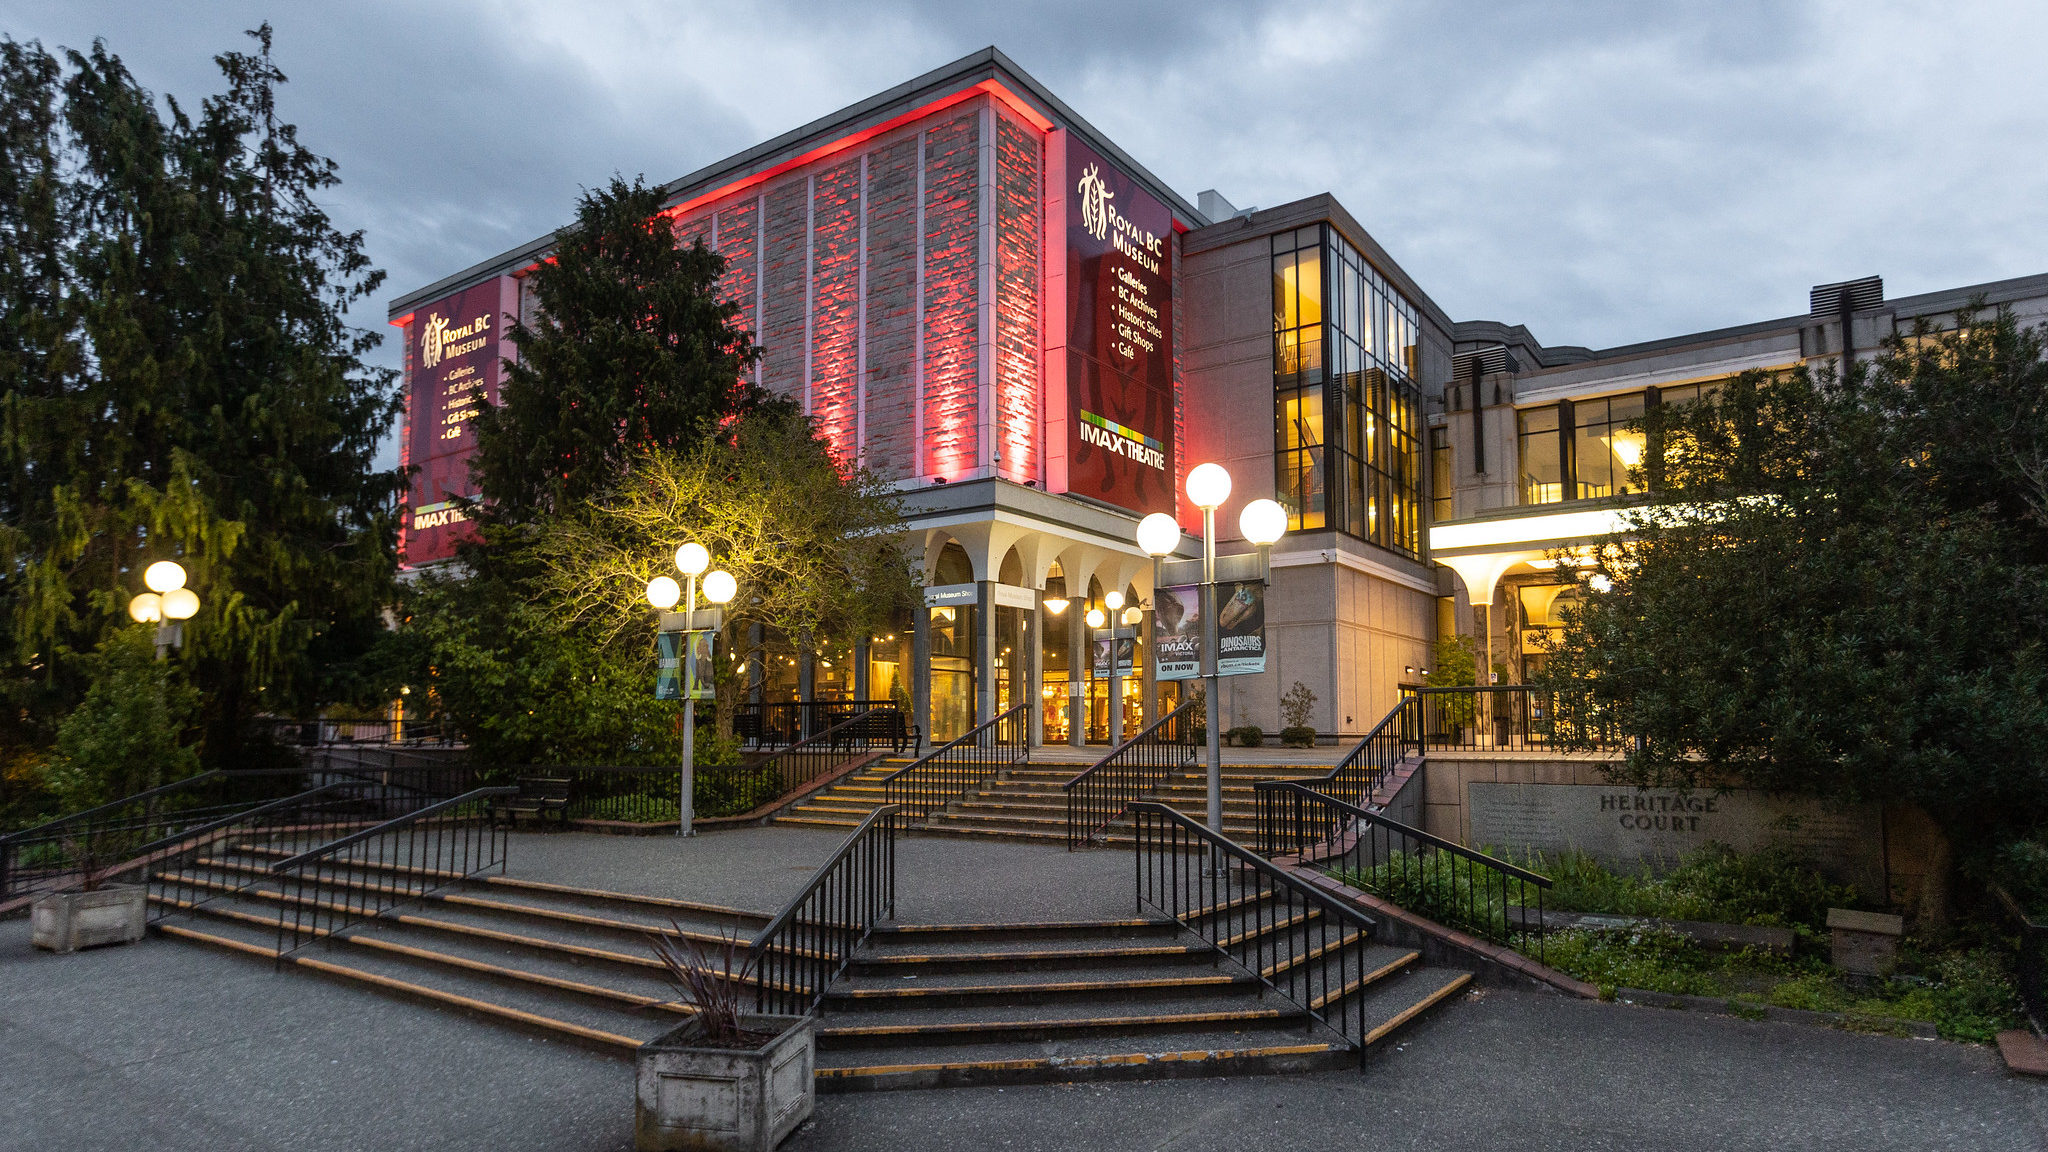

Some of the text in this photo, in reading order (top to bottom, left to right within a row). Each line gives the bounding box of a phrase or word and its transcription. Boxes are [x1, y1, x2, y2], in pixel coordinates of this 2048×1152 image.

[1108, 203, 1163, 258] ROYAL BC
[1113, 229, 1159, 275] MUSEUM
[1117, 267, 1148, 296] Galleries
[1118, 285, 1158, 319] BC Archives
[442, 314, 491, 345] ROYAL BC
[1118, 303, 1162, 339] Historic Sites
[446, 336, 487, 360] MUSEUM
[1118, 323, 1154, 353] Gift Shops
[1118, 342, 1134, 360] Café
[448, 383, 459, 395] BC
[446, 425, 462, 440] Café
[1080, 421, 1165, 471] IMAX THEATRE
[414, 510, 449, 531] IMAX
[940, 591, 961, 600] Museum
[1161, 642, 1194, 653] IMAX
[1220, 634, 1262, 650] DINOSAURS
[1161, 663, 1194, 672] ON NOW
[1600, 794, 1719, 813] HERITAGE
[1620, 814, 1700, 832] COURT
